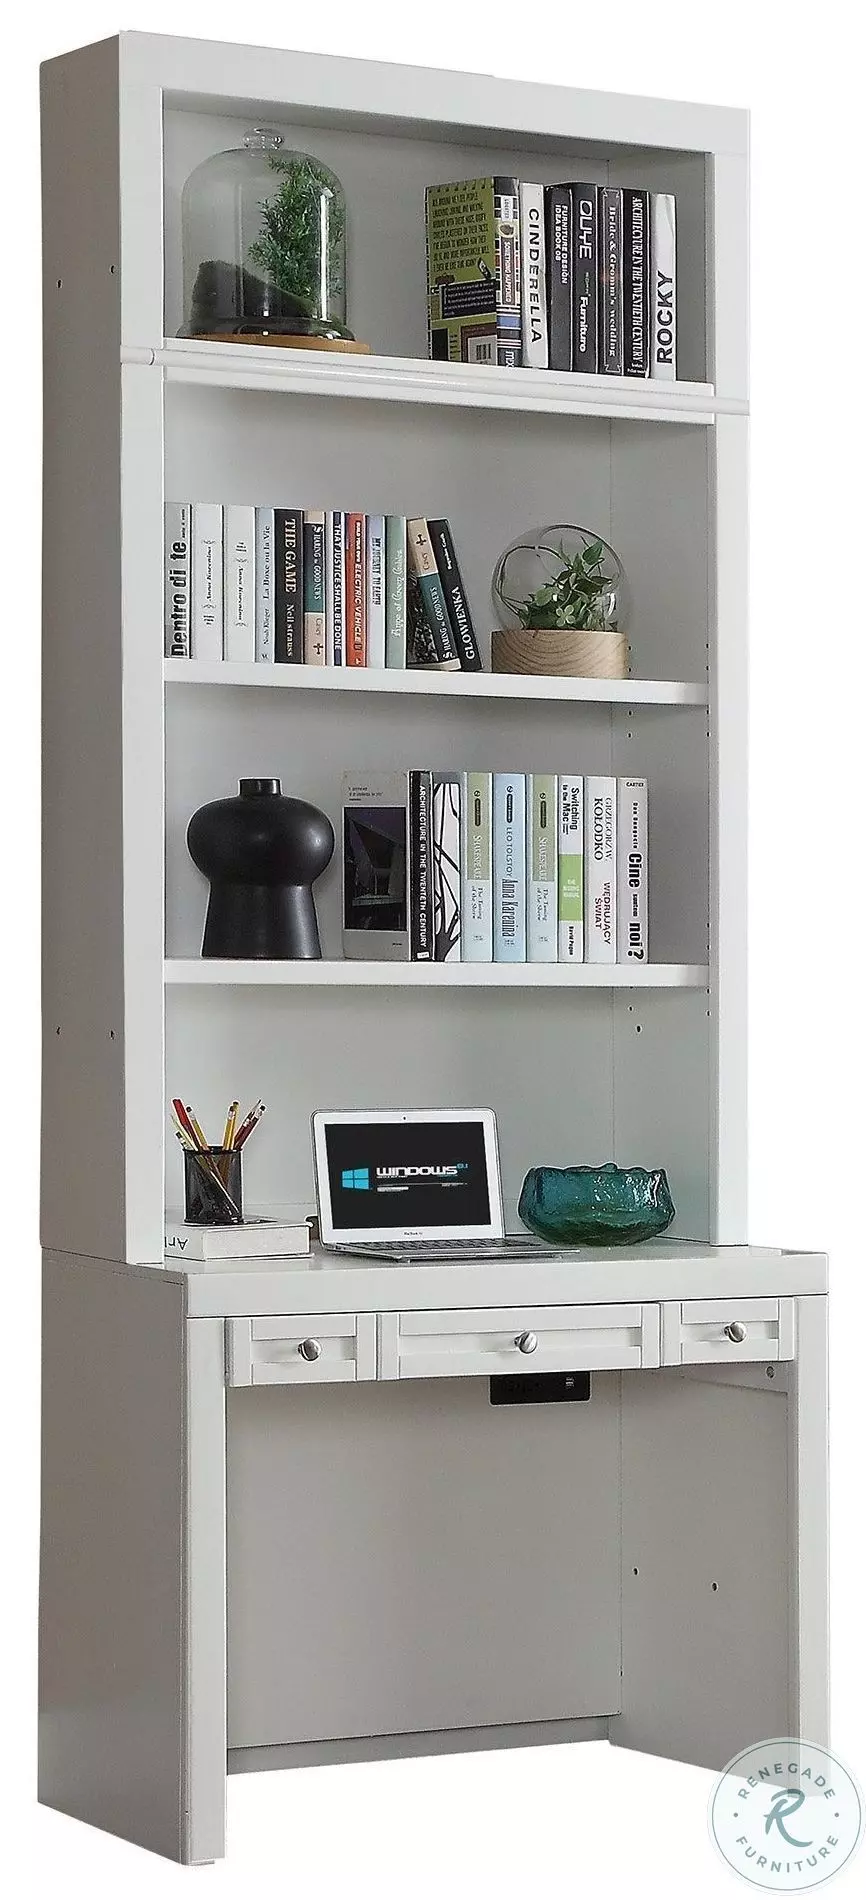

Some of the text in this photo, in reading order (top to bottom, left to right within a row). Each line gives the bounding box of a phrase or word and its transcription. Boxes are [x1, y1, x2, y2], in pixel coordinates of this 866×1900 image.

[608, 207, 616, 239] Bride
[608, 240, 616, 251] &
[529, 208, 542, 343] CINDERELLA
[561, 253, 569, 285] DESIGN
[632, 266, 643, 281] THE
[580, 296, 589, 352] Furniture
[631, 282, 643, 326] TWENTIETH
[656, 270, 673, 364] ROCKY
[608, 309, 617, 358] wedding
[631, 326, 643, 363] CENTURY
[262, 526, 270, 599] La Boxe ou la Vie
[285, 518, 296, 593] THE GAME
[169, 542, 188, 656] Dentro di te
[286, 604, 295, 623] Neil
[334, 610, 341, 624] BE
[562, 803, 570, 822] Mac
[570, 787, 580, 830] Switching
[419, 843, 427, 852] IN
[593, 797, 604, 861] KOŁODKO
[419, 854, 427, 869] THE
[629, 853, 642, 888] Cine
[501, 879, 518, 937] Anna Karenina
[602, 882, 611, 945] WĘDRUJĄCY
[419, 912, 427, 947] CENTURY
